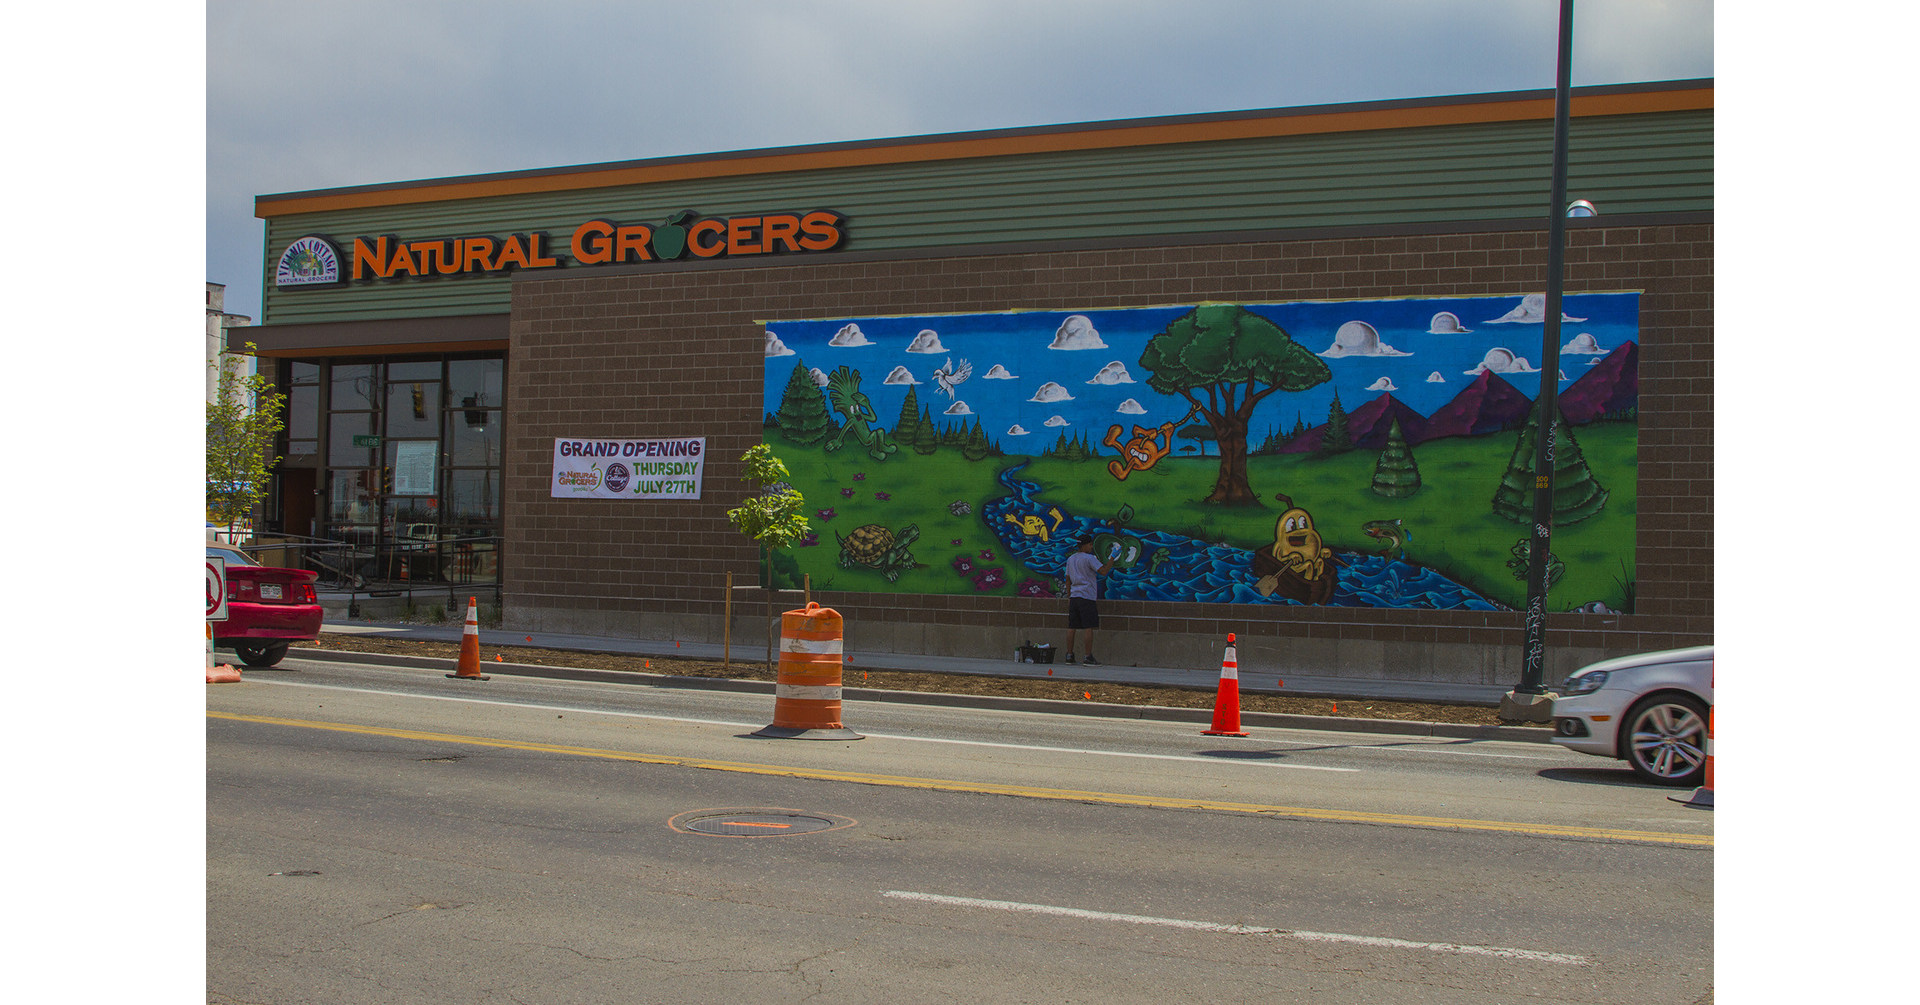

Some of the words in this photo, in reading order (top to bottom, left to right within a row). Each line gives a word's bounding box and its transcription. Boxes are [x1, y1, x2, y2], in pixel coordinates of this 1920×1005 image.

[353, 234, 557, 279] NATURAL
[571, 211, 840, 265] GROCERS
[279, 241, 306, 276] VITAMIN
[308, 240, 336, 274] COTTAGE
[560, 441, 620, 457] GRAND
[622, 441, 701, 457] OPENING
[566, 471, 598, 479] NATURAL
[633, 462, 699, 476] THURSDAY
[558, 477, 597, 486] GROCERS
[633, 480, 664, 494] JULY
[665, 480, 696, 494] 27TH
